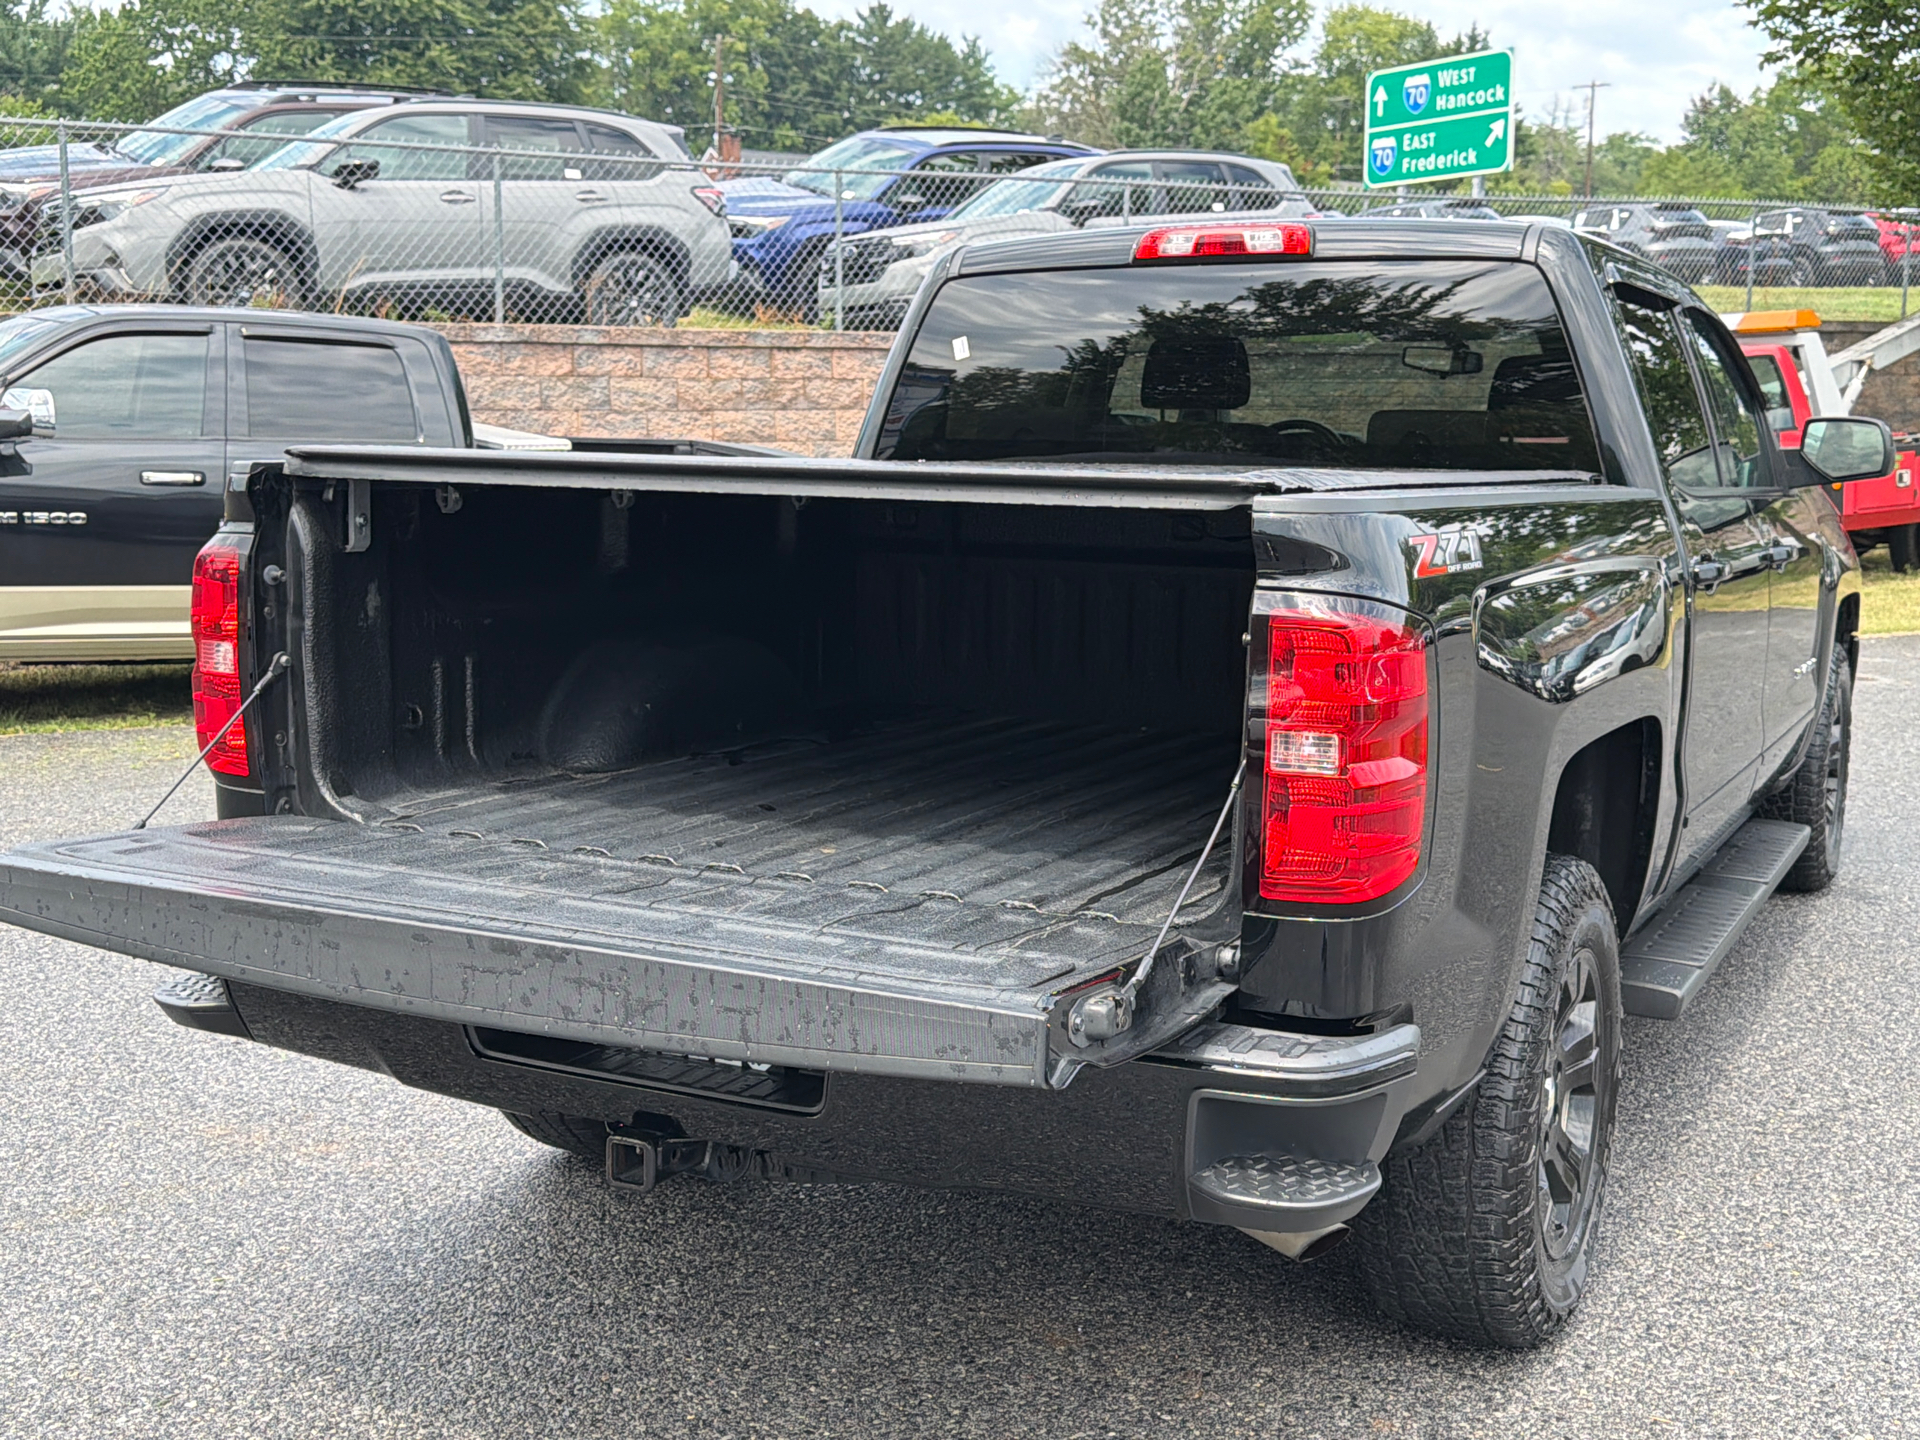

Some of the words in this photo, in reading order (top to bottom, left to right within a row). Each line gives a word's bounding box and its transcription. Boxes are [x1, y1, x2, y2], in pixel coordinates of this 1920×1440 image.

[1437, 66, 1476, 88] WEST
[1407, 86, 1427, 106] 70
[1435, 84, 1505, 111] Hancock
[1402, 132, 1436, 151] EAST
[1373, 149, 1393, 167] 70
[1401, 148, 1477, 173] Frederick
[22, 511, 87, 525] 1500
[1409, 530, 1482, 578] Z71
